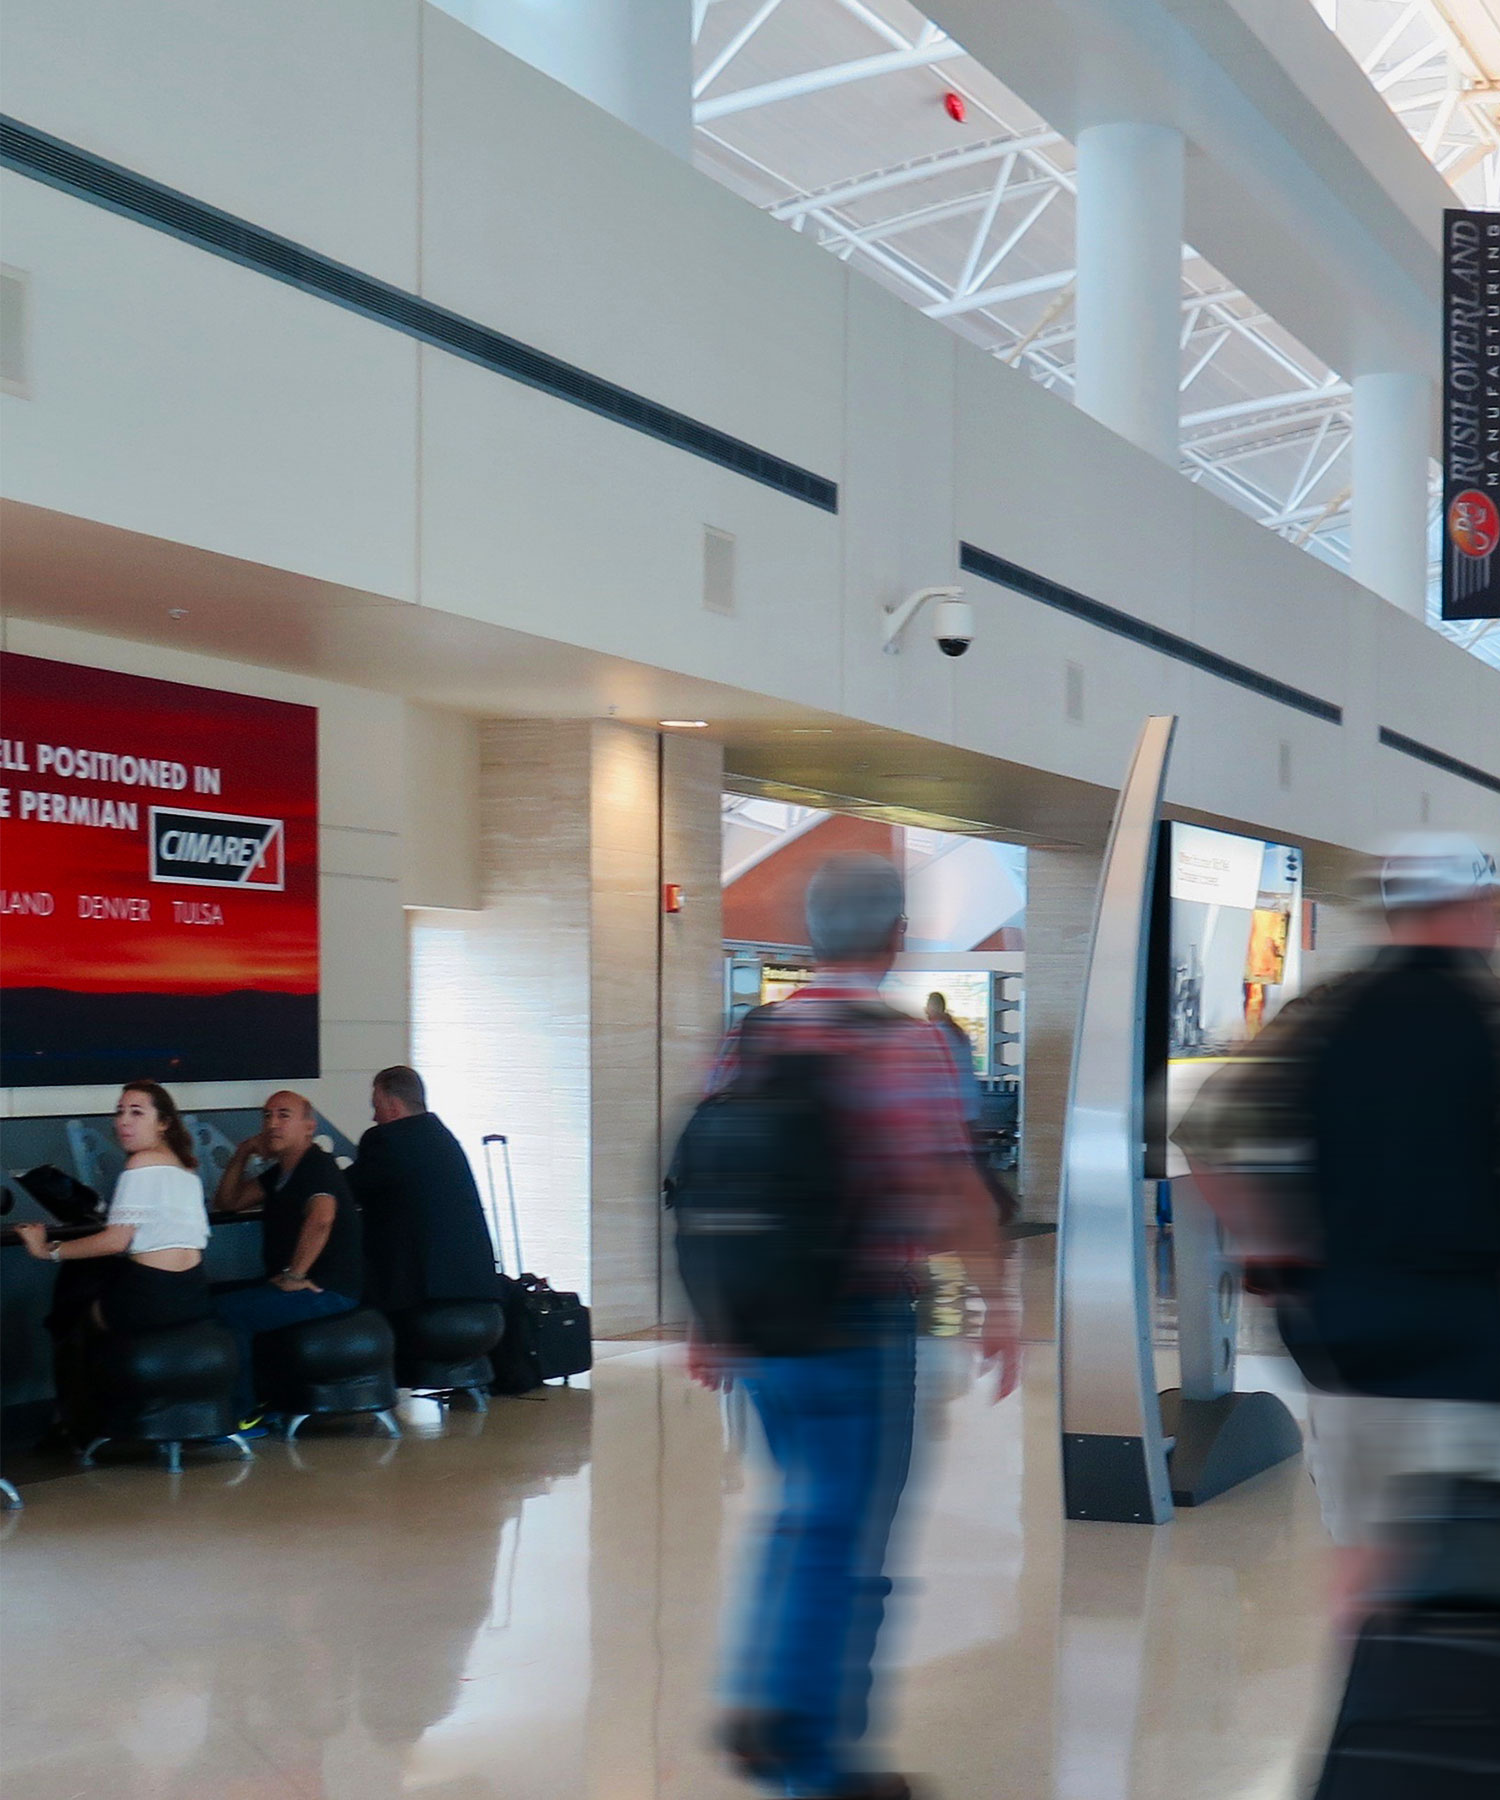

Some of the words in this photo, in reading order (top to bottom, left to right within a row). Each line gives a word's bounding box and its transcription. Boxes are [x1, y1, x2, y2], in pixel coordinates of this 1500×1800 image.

[1451, 220, 1486, 486] RUSH-OVERLAND
[1486, 224, 1500, 486] MANUFACTURING
[37, 743, 187, 790] POSITIONED
[194, 765, 221, 795] IN
[20, 790, 138, 831] PERMIAN
[160, 829, 267, 869] CIMAREX
[78, 895, 150, 922] DENVER
[172, 900, 224, 926] TULSA
